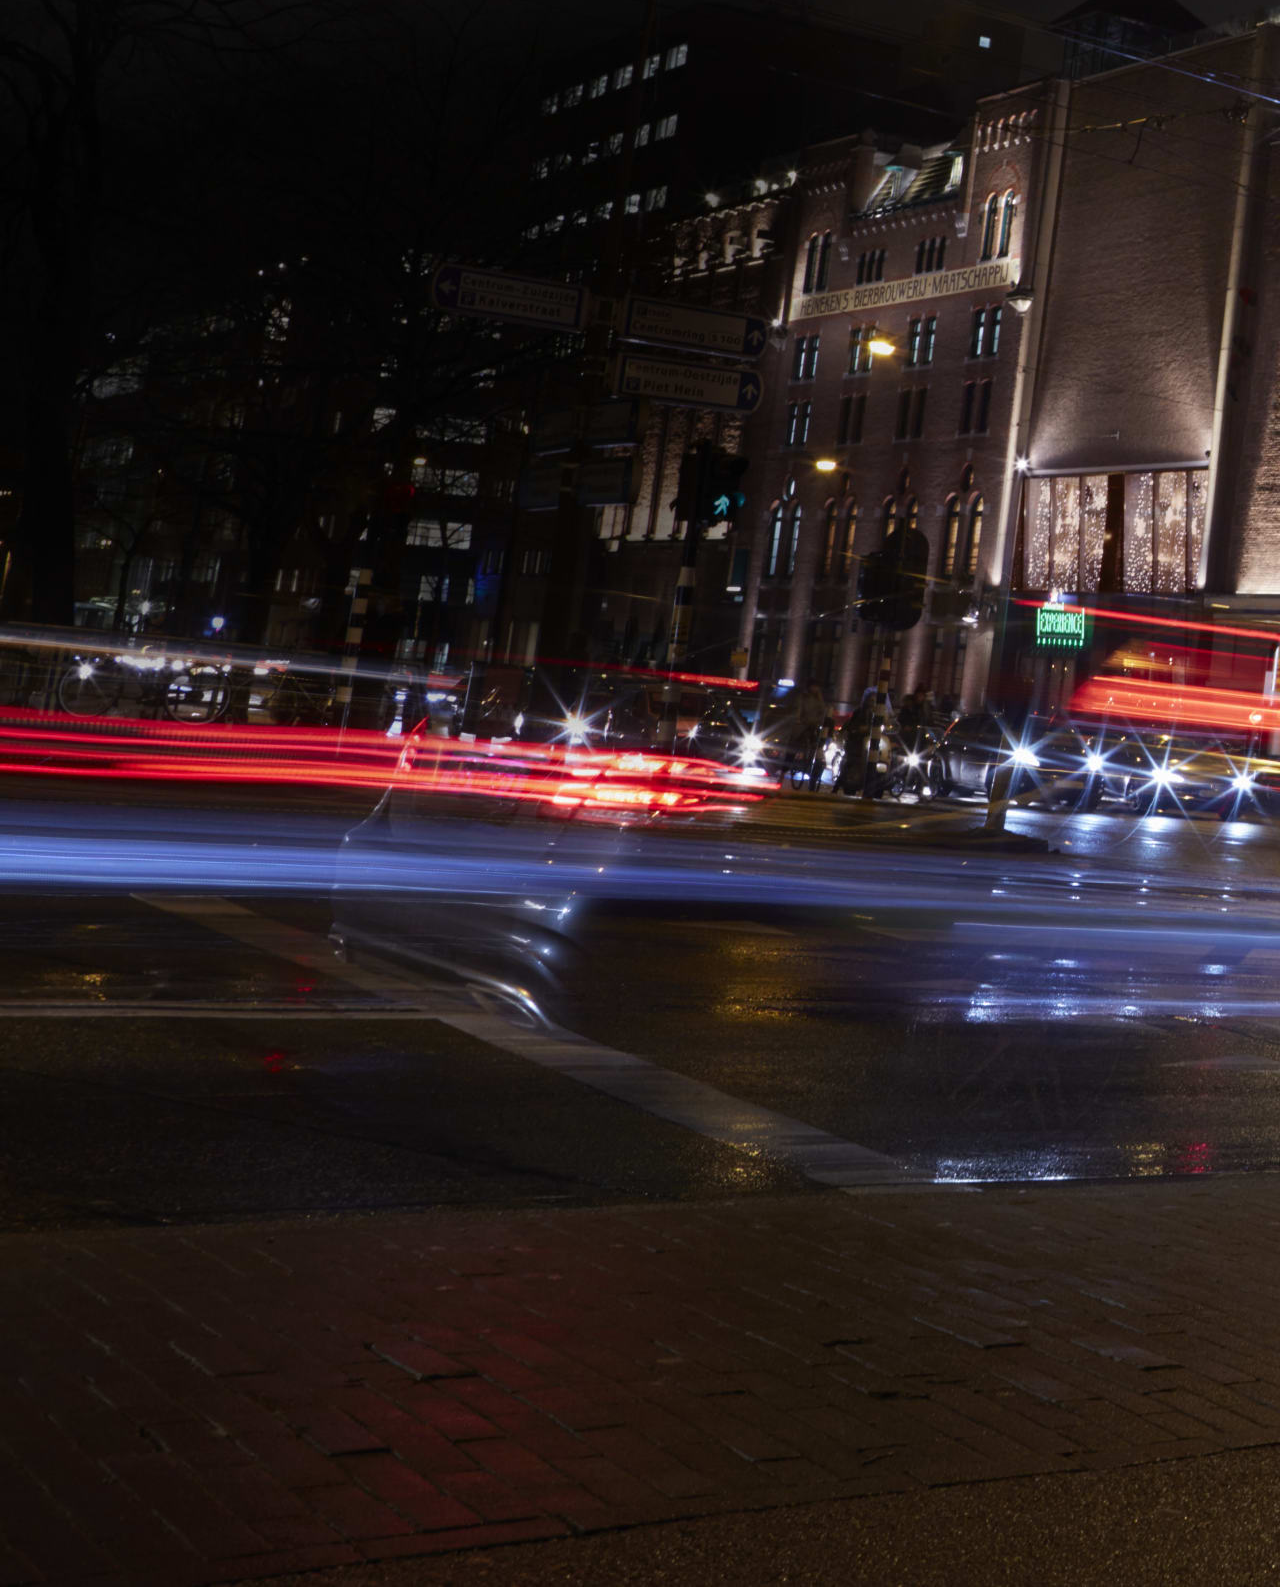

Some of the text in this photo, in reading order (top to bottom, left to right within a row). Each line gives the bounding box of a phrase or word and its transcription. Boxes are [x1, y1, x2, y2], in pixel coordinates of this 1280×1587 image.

[853, 278, 928, 308] BIERBROUWERIJ
[932, 264, 1009, 294] MAATSCHAPPIJ
[643, 380, 705, 398] Piet Hein
